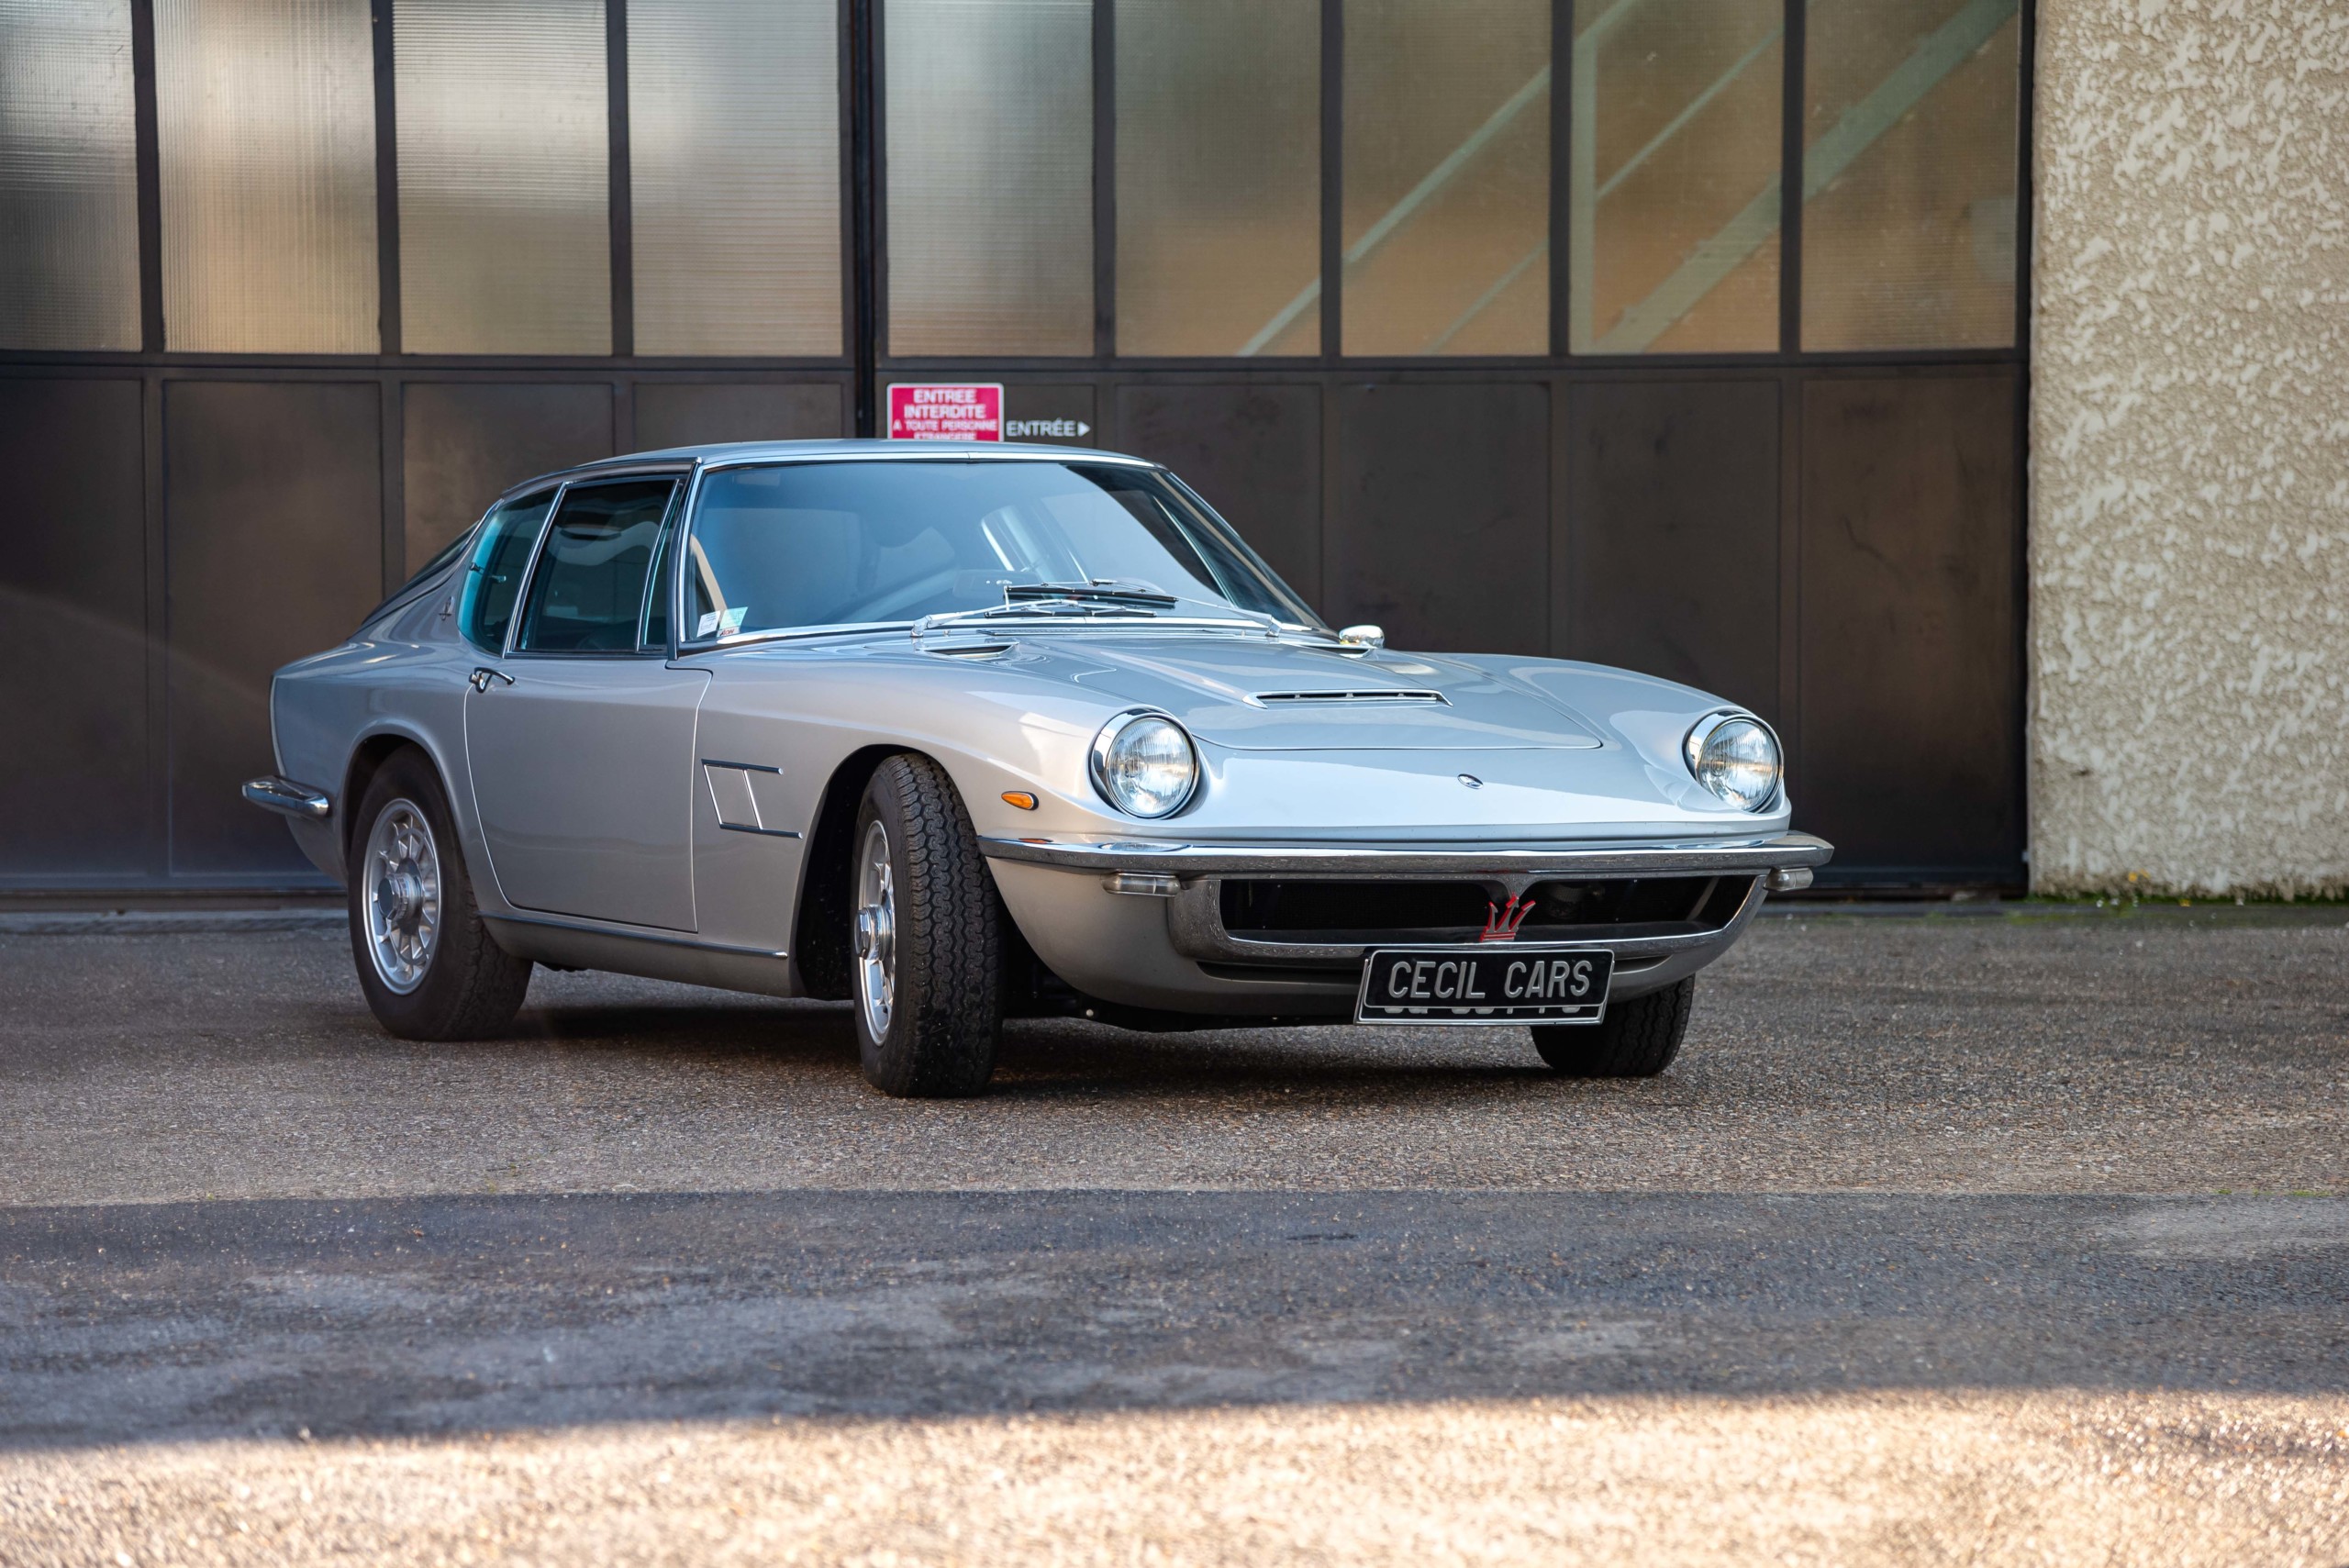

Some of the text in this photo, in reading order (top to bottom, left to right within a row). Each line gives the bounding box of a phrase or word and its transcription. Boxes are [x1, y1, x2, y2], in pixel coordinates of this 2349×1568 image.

[913, 388, 977, 404] ENTREE
[904, 404, 986, 419] INTERDITE
[906, 419, 939, 430] TOUTE
[941, 419, 998, 430] PERSONNE
[1006, 417, 1075, 437] ENTRÉE
[1387, 960, 1593, 999] CECIL CARS
